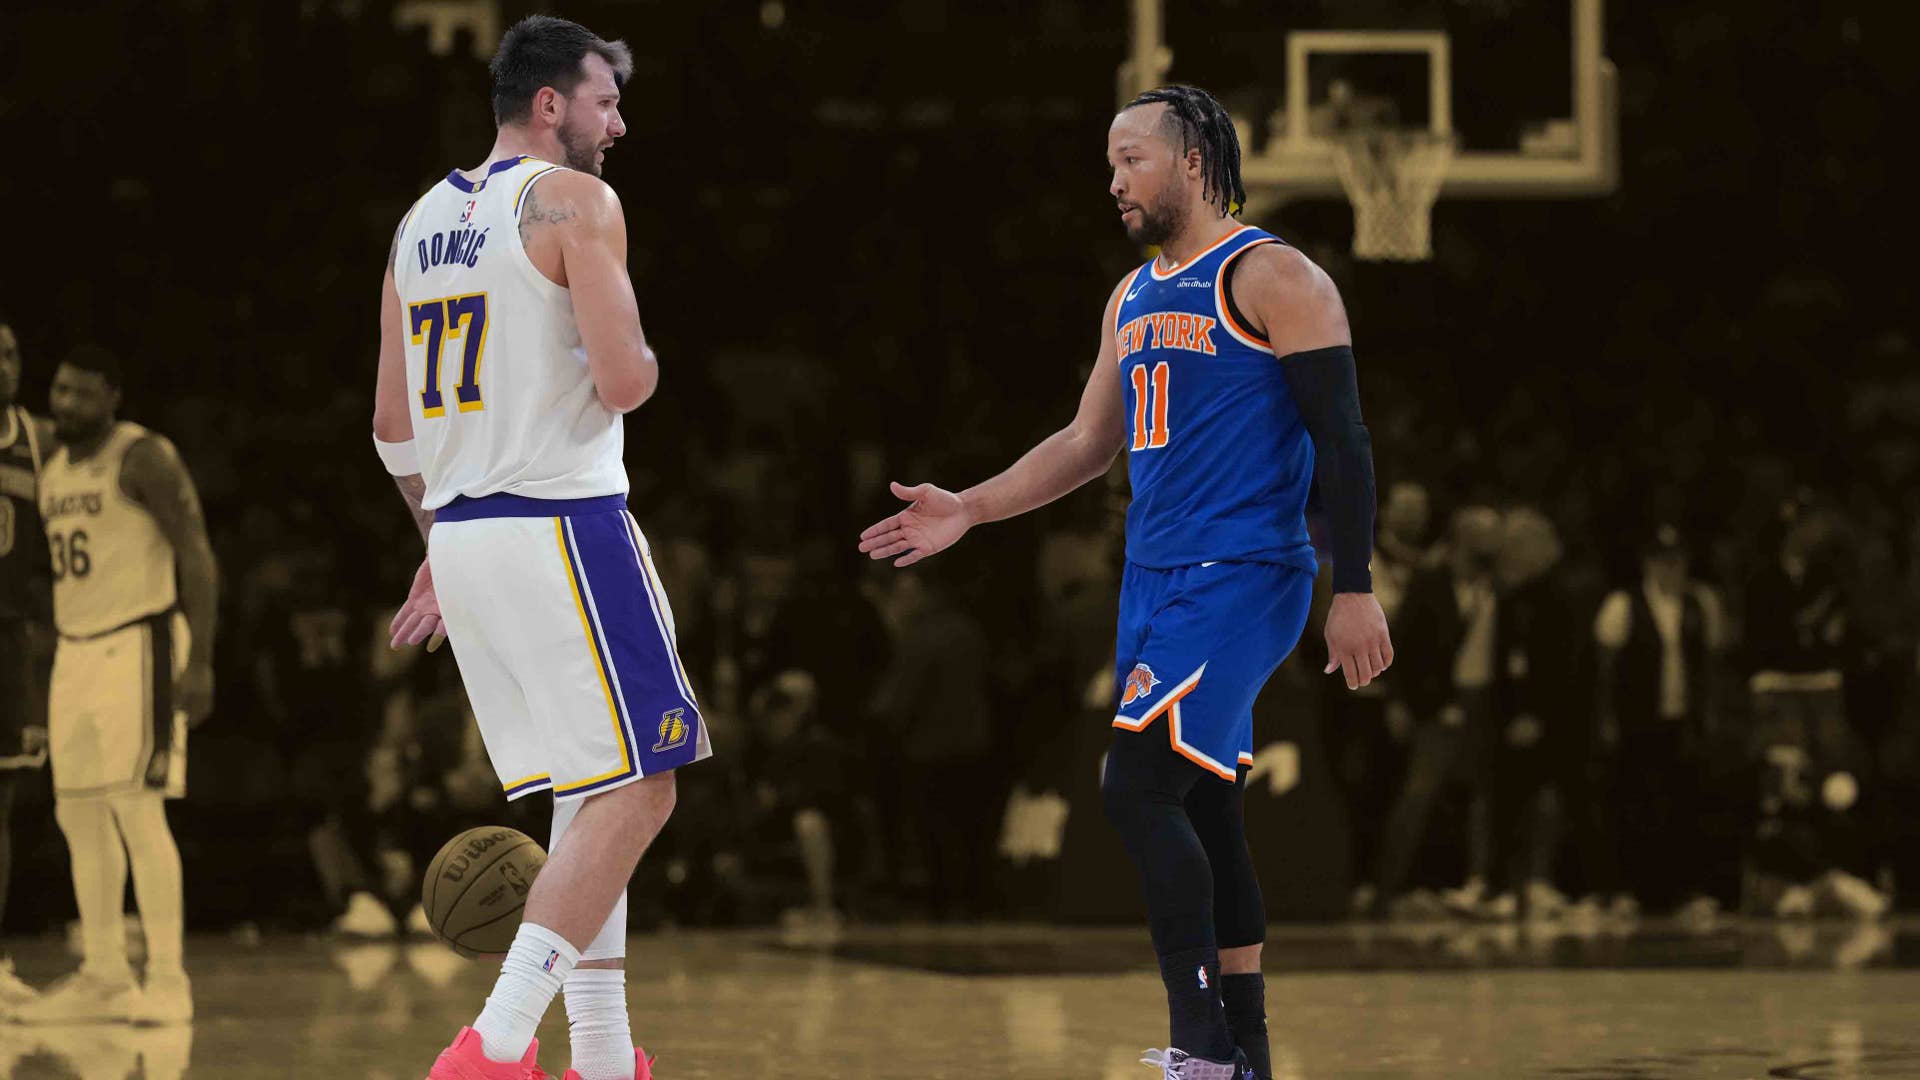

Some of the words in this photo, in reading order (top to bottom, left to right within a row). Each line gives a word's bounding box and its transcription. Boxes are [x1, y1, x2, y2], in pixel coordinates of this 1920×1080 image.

[418, 222, 490, 275] DONČIĆ
[408, 291, 489, 419] 77
[1150, 311, 1217, 356] YORK
[1130, 361, 1170, 452] 11
[49, 528, 91, 580] 36
